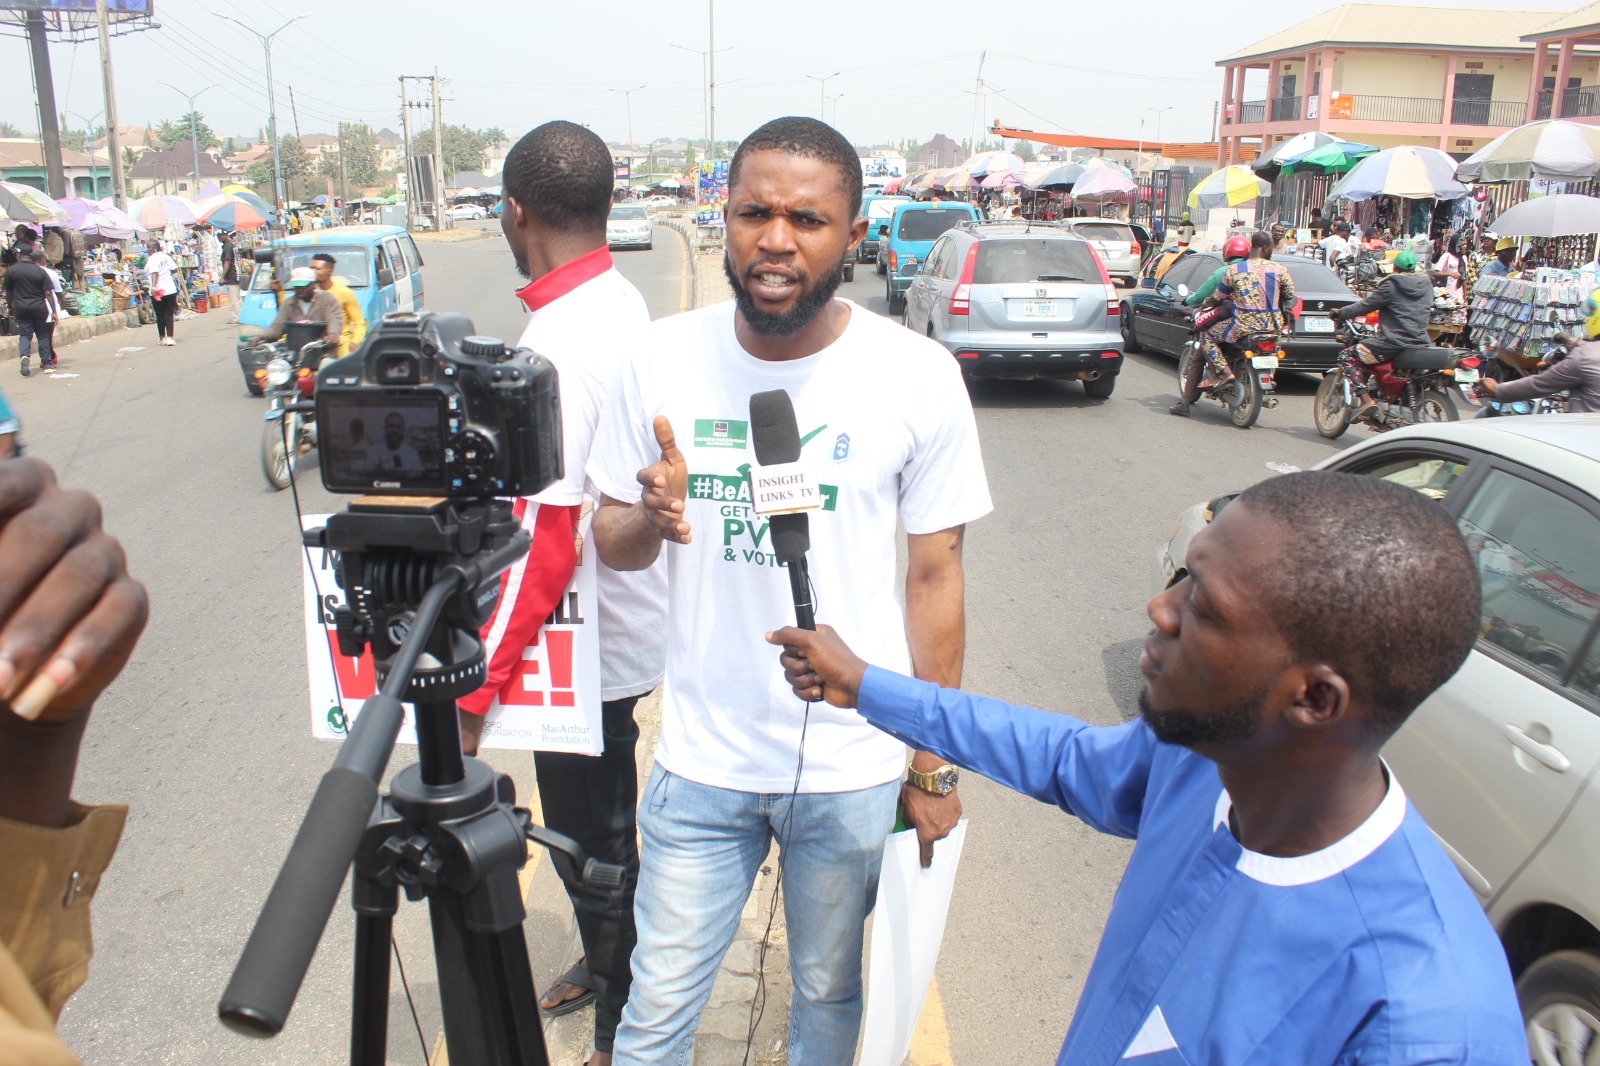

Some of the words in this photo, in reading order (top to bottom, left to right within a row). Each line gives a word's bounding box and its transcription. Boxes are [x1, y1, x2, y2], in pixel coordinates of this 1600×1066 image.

[1195, 309, 1215, 325] TOMMY
[758, 474, 806, 488] INSIGHT
[760, 490, 794, 502] LINKS
[799, 487, 814, 498] TV
[720, 505, 751, 518] GET
[724, 519, 769, 549] PV
[723, 548, 737, 562] &
[742, 549, 788, 567] VOT
[484, 721, 502, 729] ORD
[541, 724, 591, 734] MacArthur
[541, 734, 590, 745] Foundation
